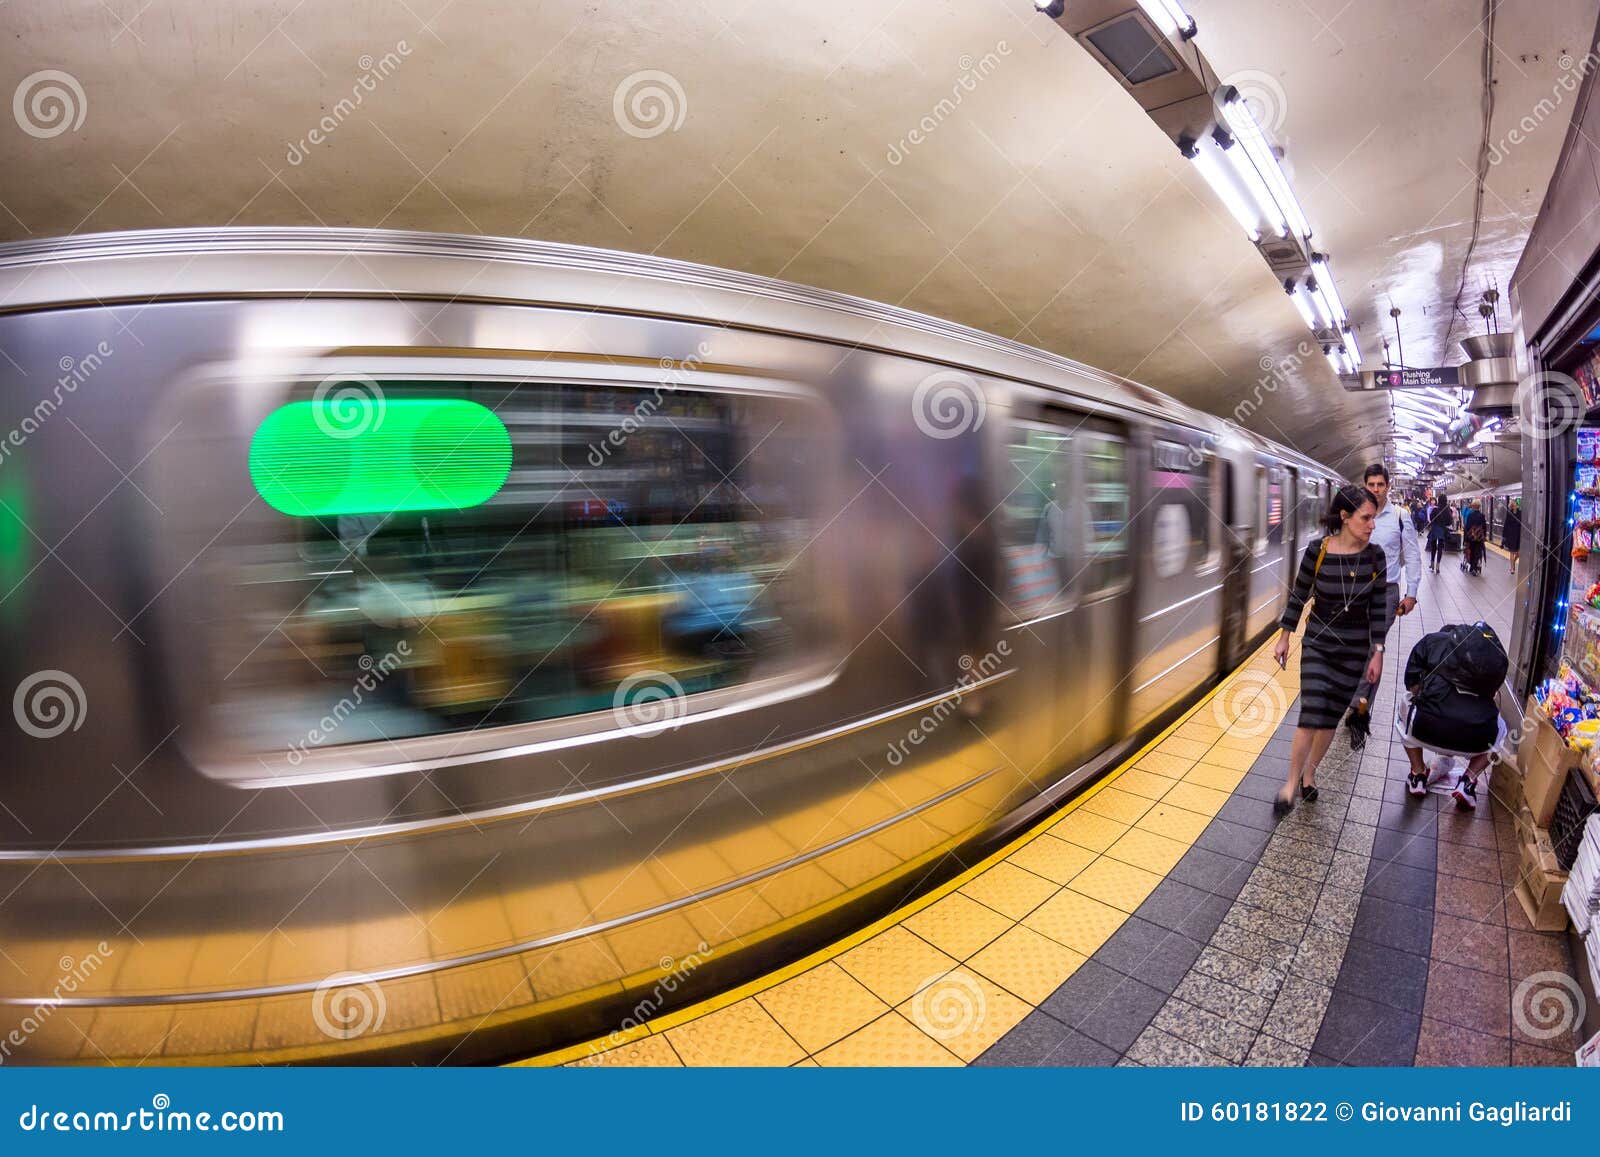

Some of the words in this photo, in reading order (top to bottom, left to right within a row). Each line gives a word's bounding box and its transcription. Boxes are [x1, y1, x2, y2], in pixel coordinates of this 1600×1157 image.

[1402, 371, 1430, 379] Flushing
[1402, 377, 1419, 385] Main
[1420, 377, 1442, 385] Street
